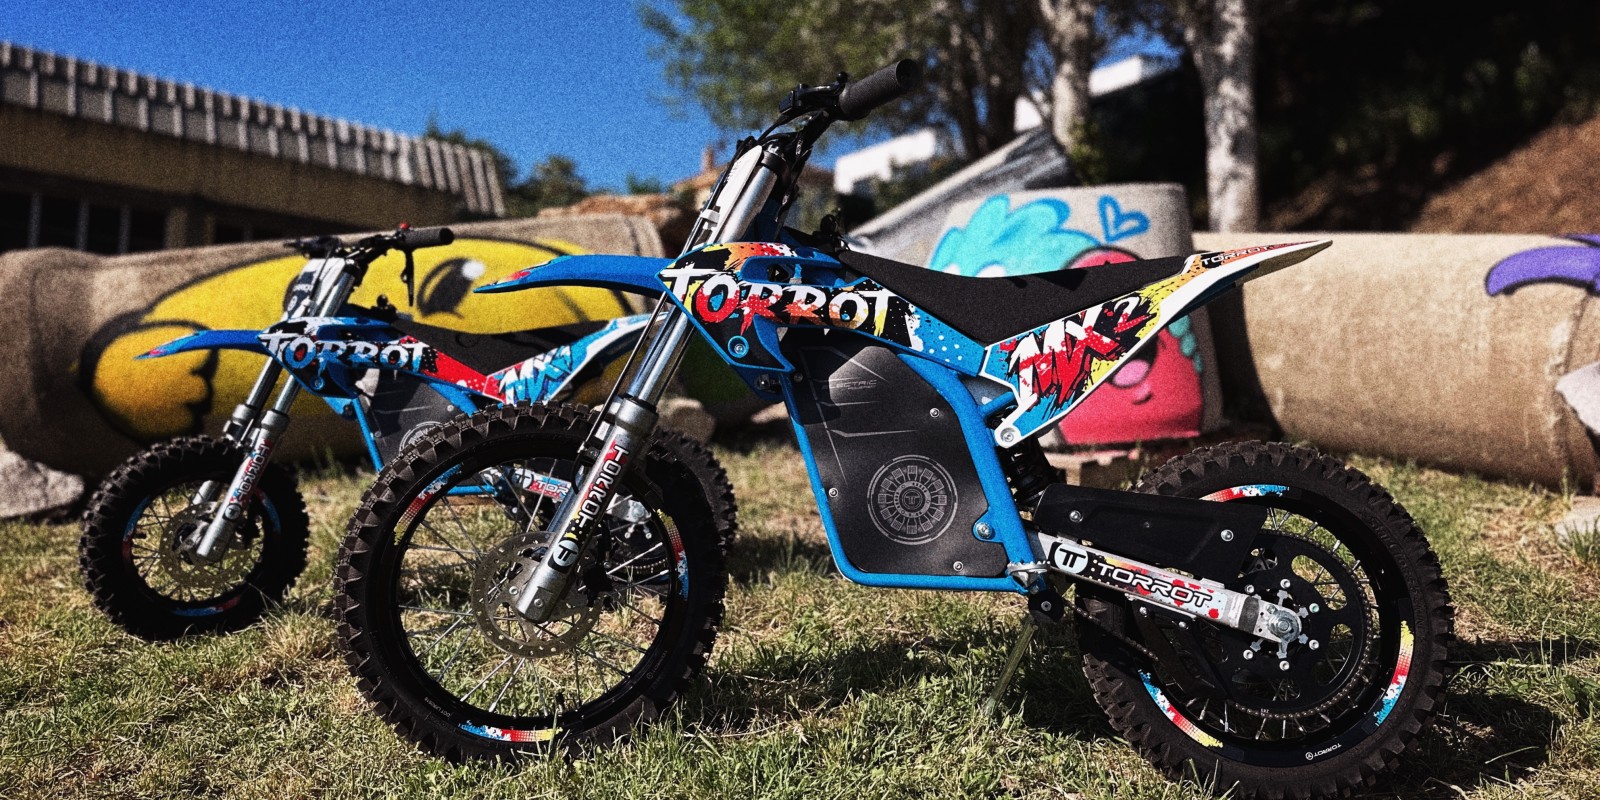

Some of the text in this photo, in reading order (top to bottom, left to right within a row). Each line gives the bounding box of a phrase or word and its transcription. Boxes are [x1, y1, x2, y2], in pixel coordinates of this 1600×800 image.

[1201, 247, 1269, 265] TORROT
[660, 262, 900, 337] TORROT
[258, 330, 429, 376] TORROT
[237, 444, 270, 501] TORROT
[536, 480, 569, 496] TOR
[578, 445, 630, 528] TORROT
[1098, 561, 1212, 608] TORROT
